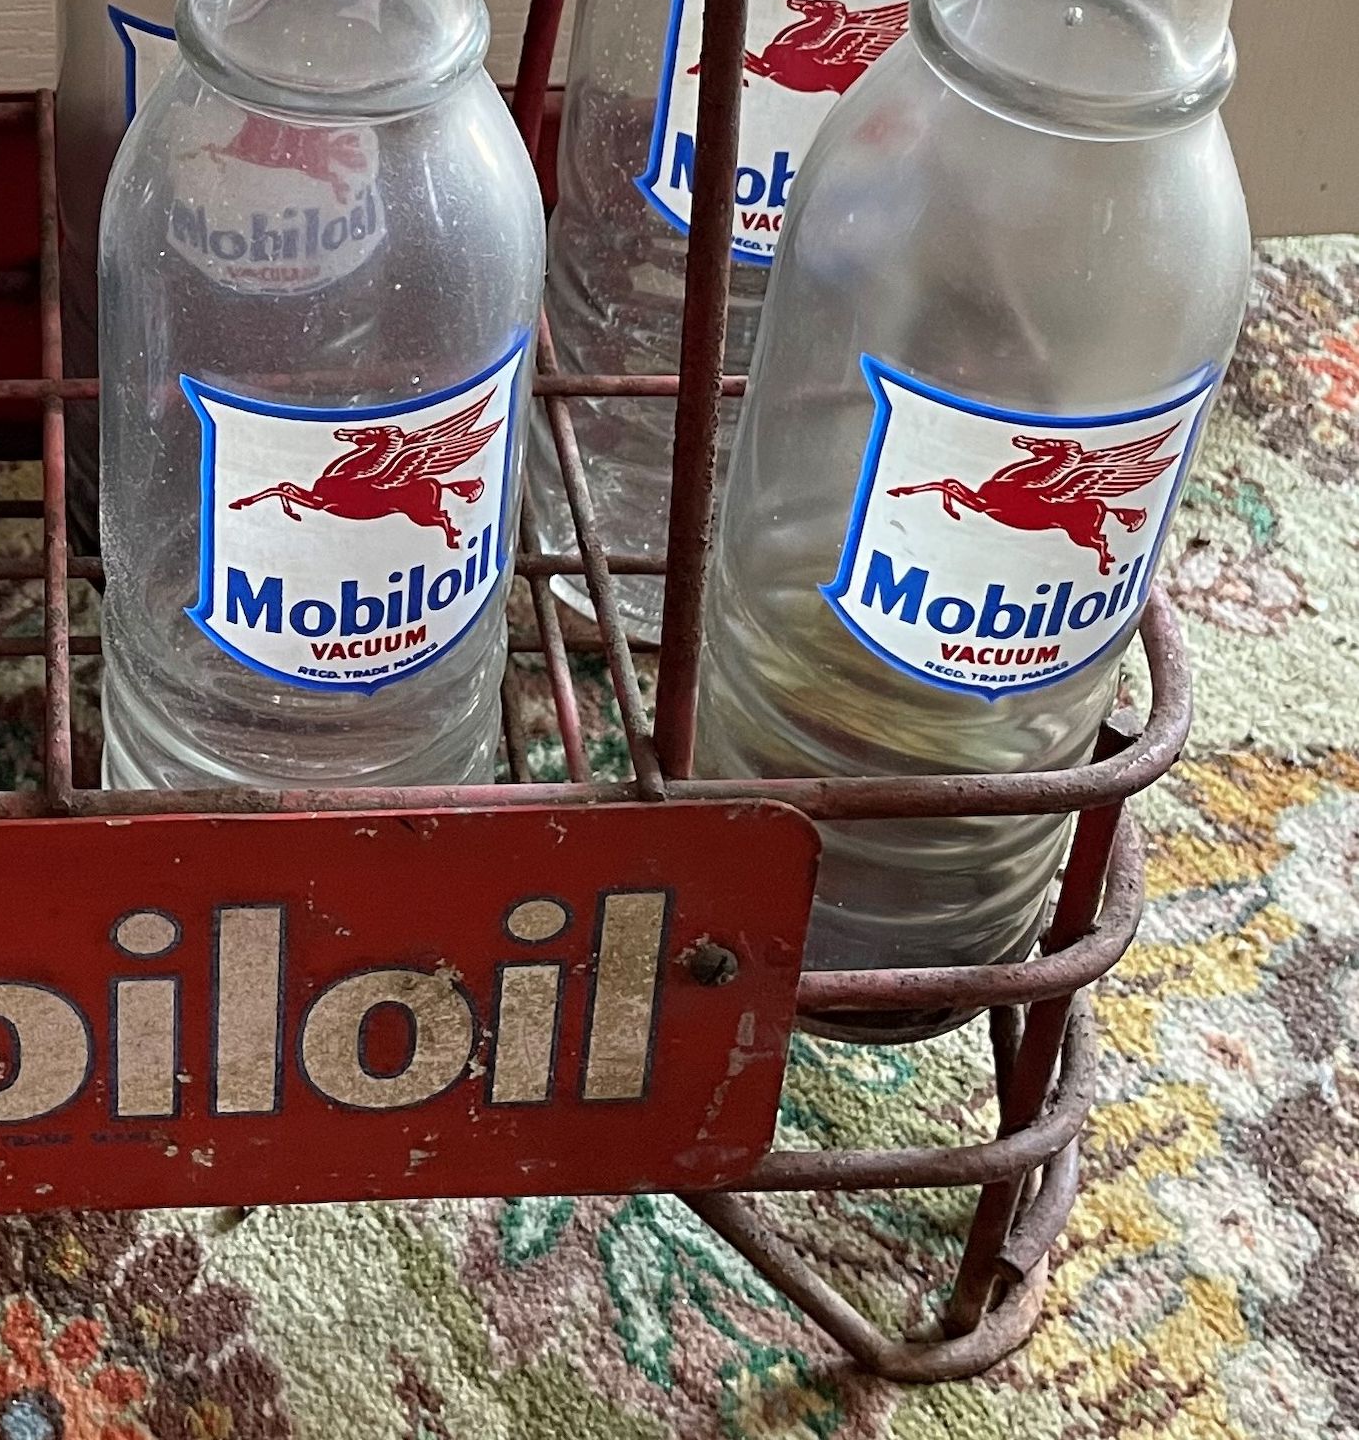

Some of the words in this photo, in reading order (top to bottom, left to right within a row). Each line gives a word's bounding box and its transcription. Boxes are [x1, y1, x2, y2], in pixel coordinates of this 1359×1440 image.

[741, 211, 783, 232] VAC
[226, 524, 491, 637] Mobiloil
[861, 549, 1145, 640] Mobiloil
[311, 625, 426, 660] VACUUM
[941, 643, 1061, 666] VACUUM
[344, 665, 390, 678] TRADE
[971, 672, 1017, 683] TRADE
[1021, 660, 1070, 680] MARKS
